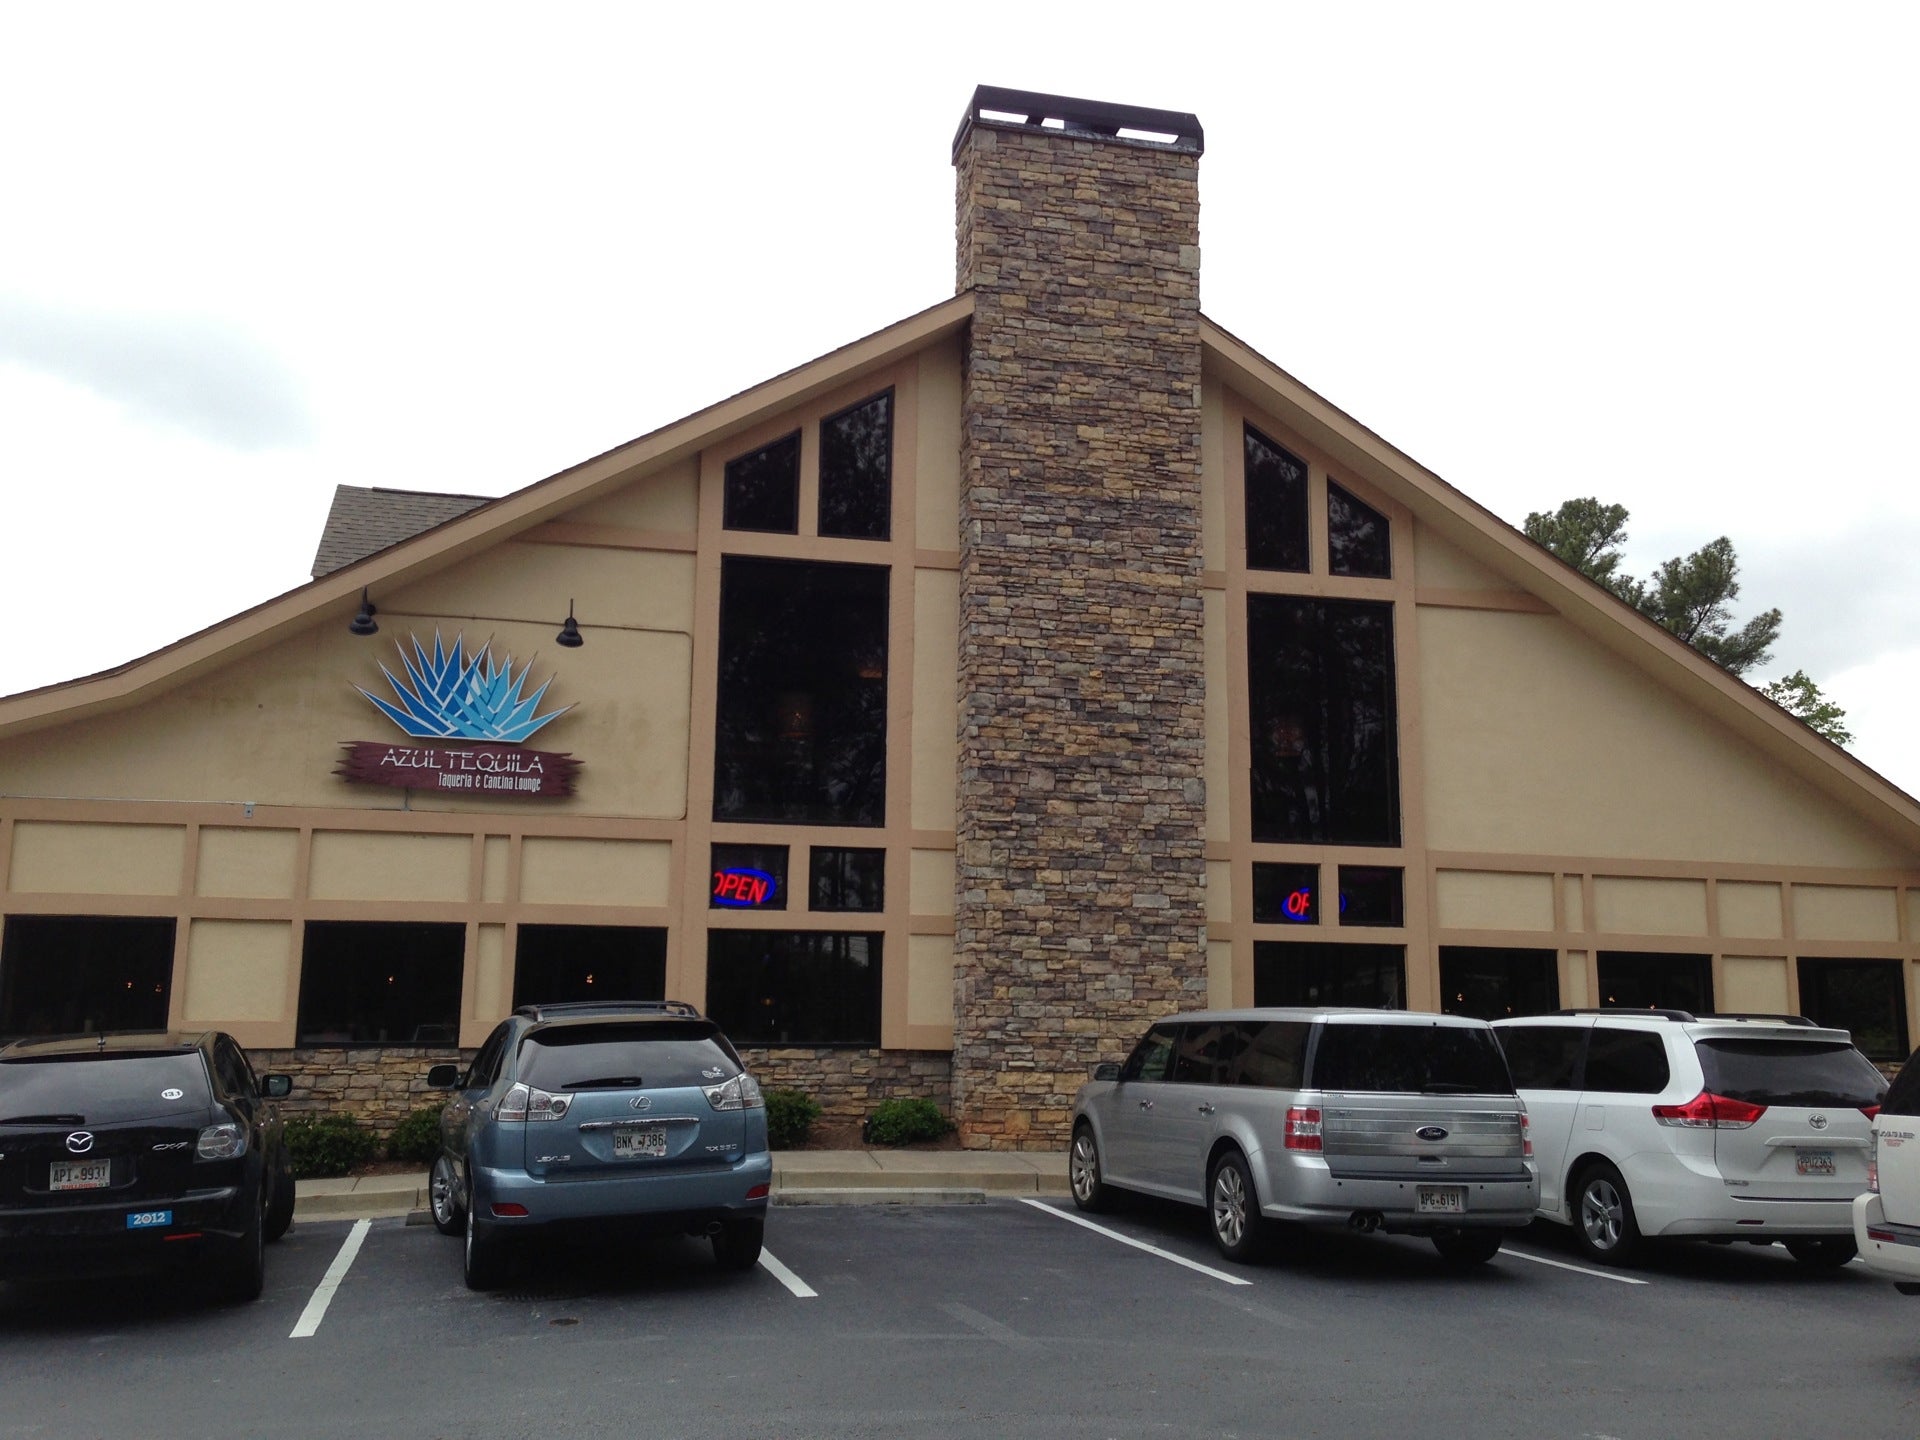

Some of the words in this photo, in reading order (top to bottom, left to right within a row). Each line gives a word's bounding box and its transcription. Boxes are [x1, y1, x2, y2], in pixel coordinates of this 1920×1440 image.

[380, 748, 442, 768] AZUL
[445, 751, 543, 773] TEQUILA
[438, 772, 472, 788] Taqueria
[483, 774, 513, 789] Cantina
[514, 776, 541, 792] Lounge
[133, 1212, 166, 1225] 2012
